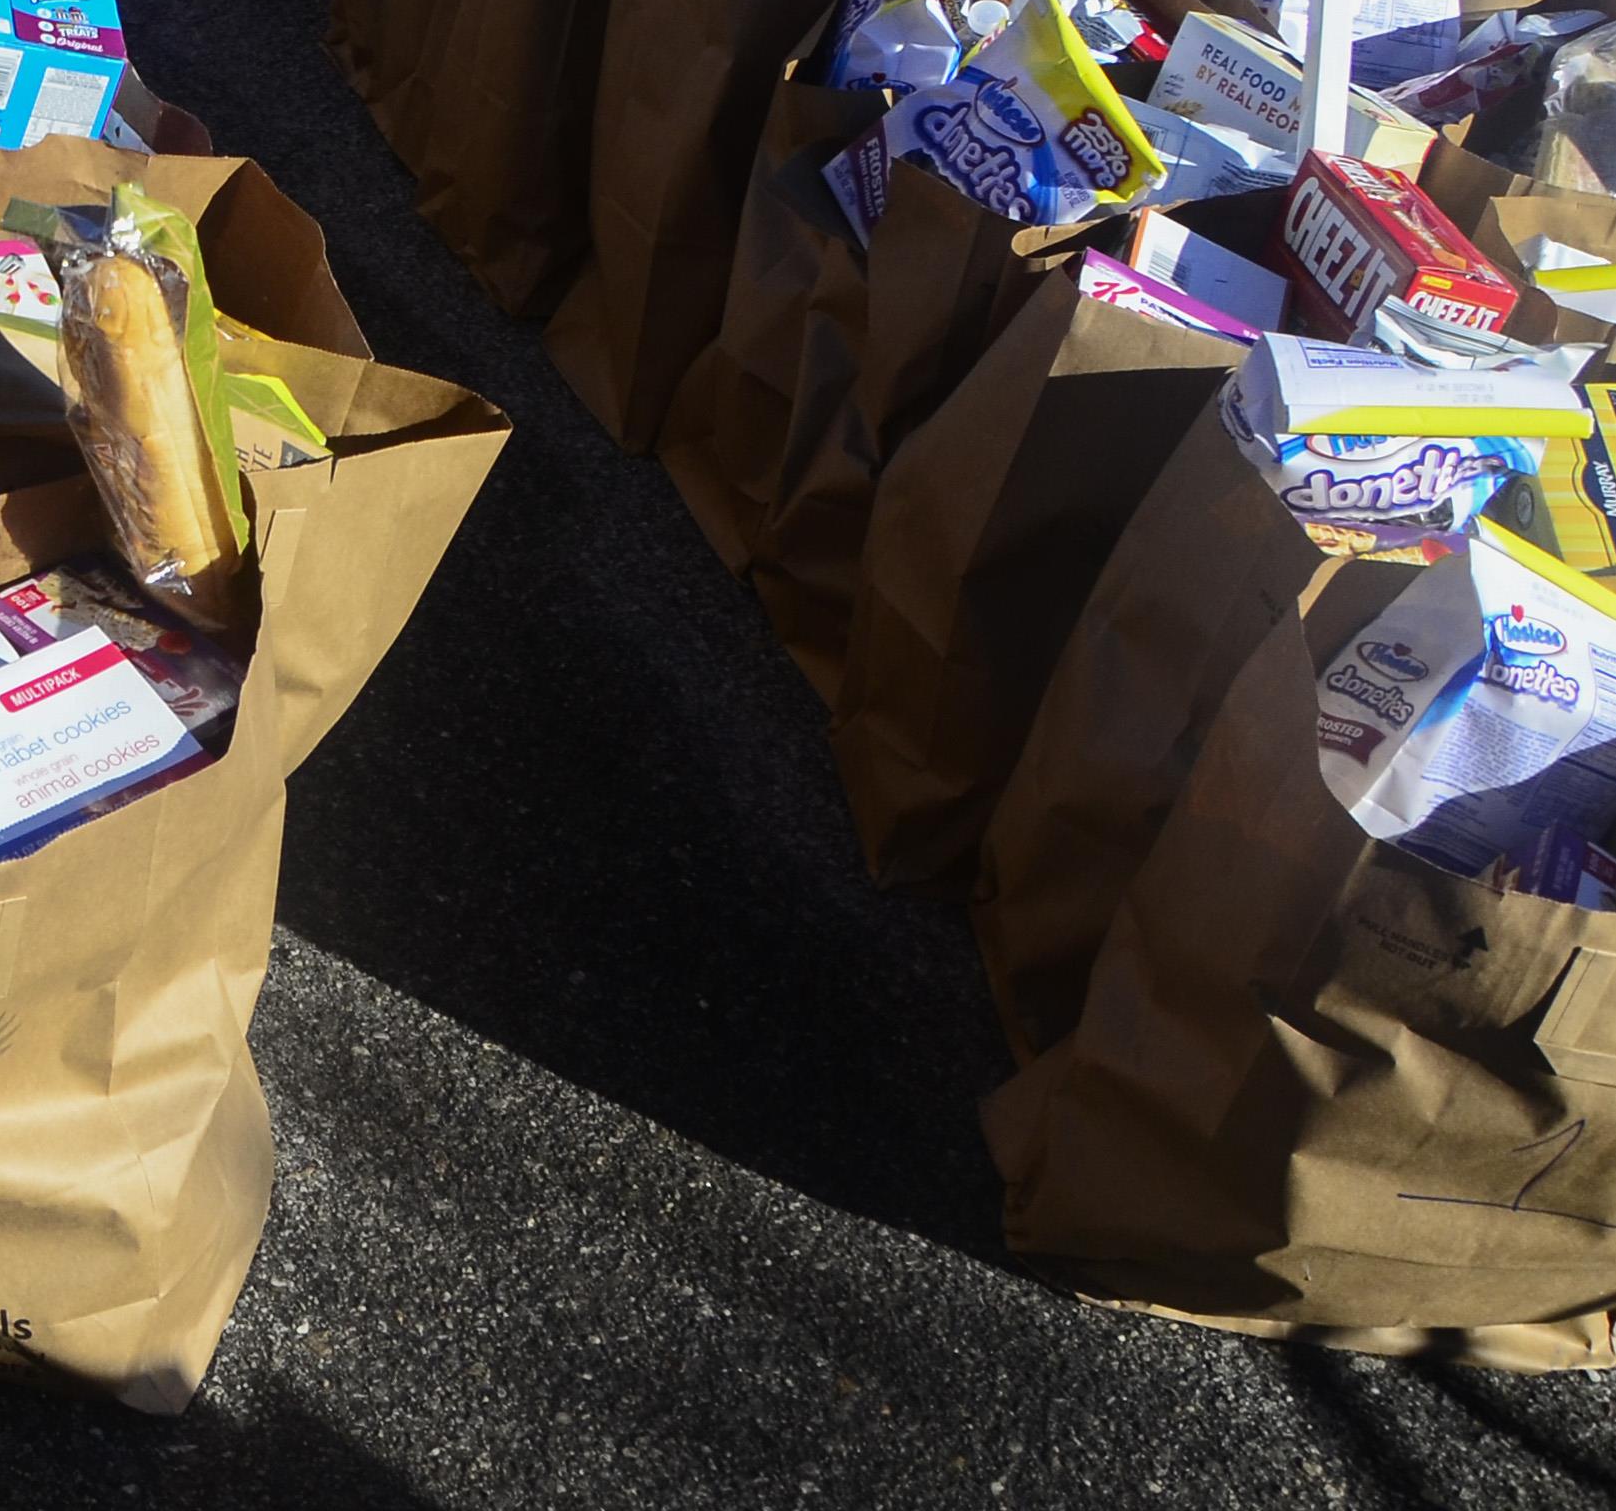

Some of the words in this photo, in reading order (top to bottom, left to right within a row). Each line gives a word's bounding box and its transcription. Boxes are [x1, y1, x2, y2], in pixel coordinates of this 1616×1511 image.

[56, 36, 104, 53] Original
[1194, 65, 1215, 85] BY
[1215, 78, 1253, 111] REAL
[1201, 43, 1237, 76] REAL
[1239, 67, 1287, 103] FOOD
[1063, 125, 1117, 188] more
[1083, 112, 1127, 178] 25%
[1500, 620, 1562, 648] Hostess
[9, 666, 83, 709] MULTIPACK
[1328, 665, 1414, 726] donettes
[53, 698, 133, 747] cookies
[14, 762, 50, 788] whole
[51, 751, 80, 775] grain
[15, 770, 80, 810] animal
[82, 731, 161, 780] cookies
